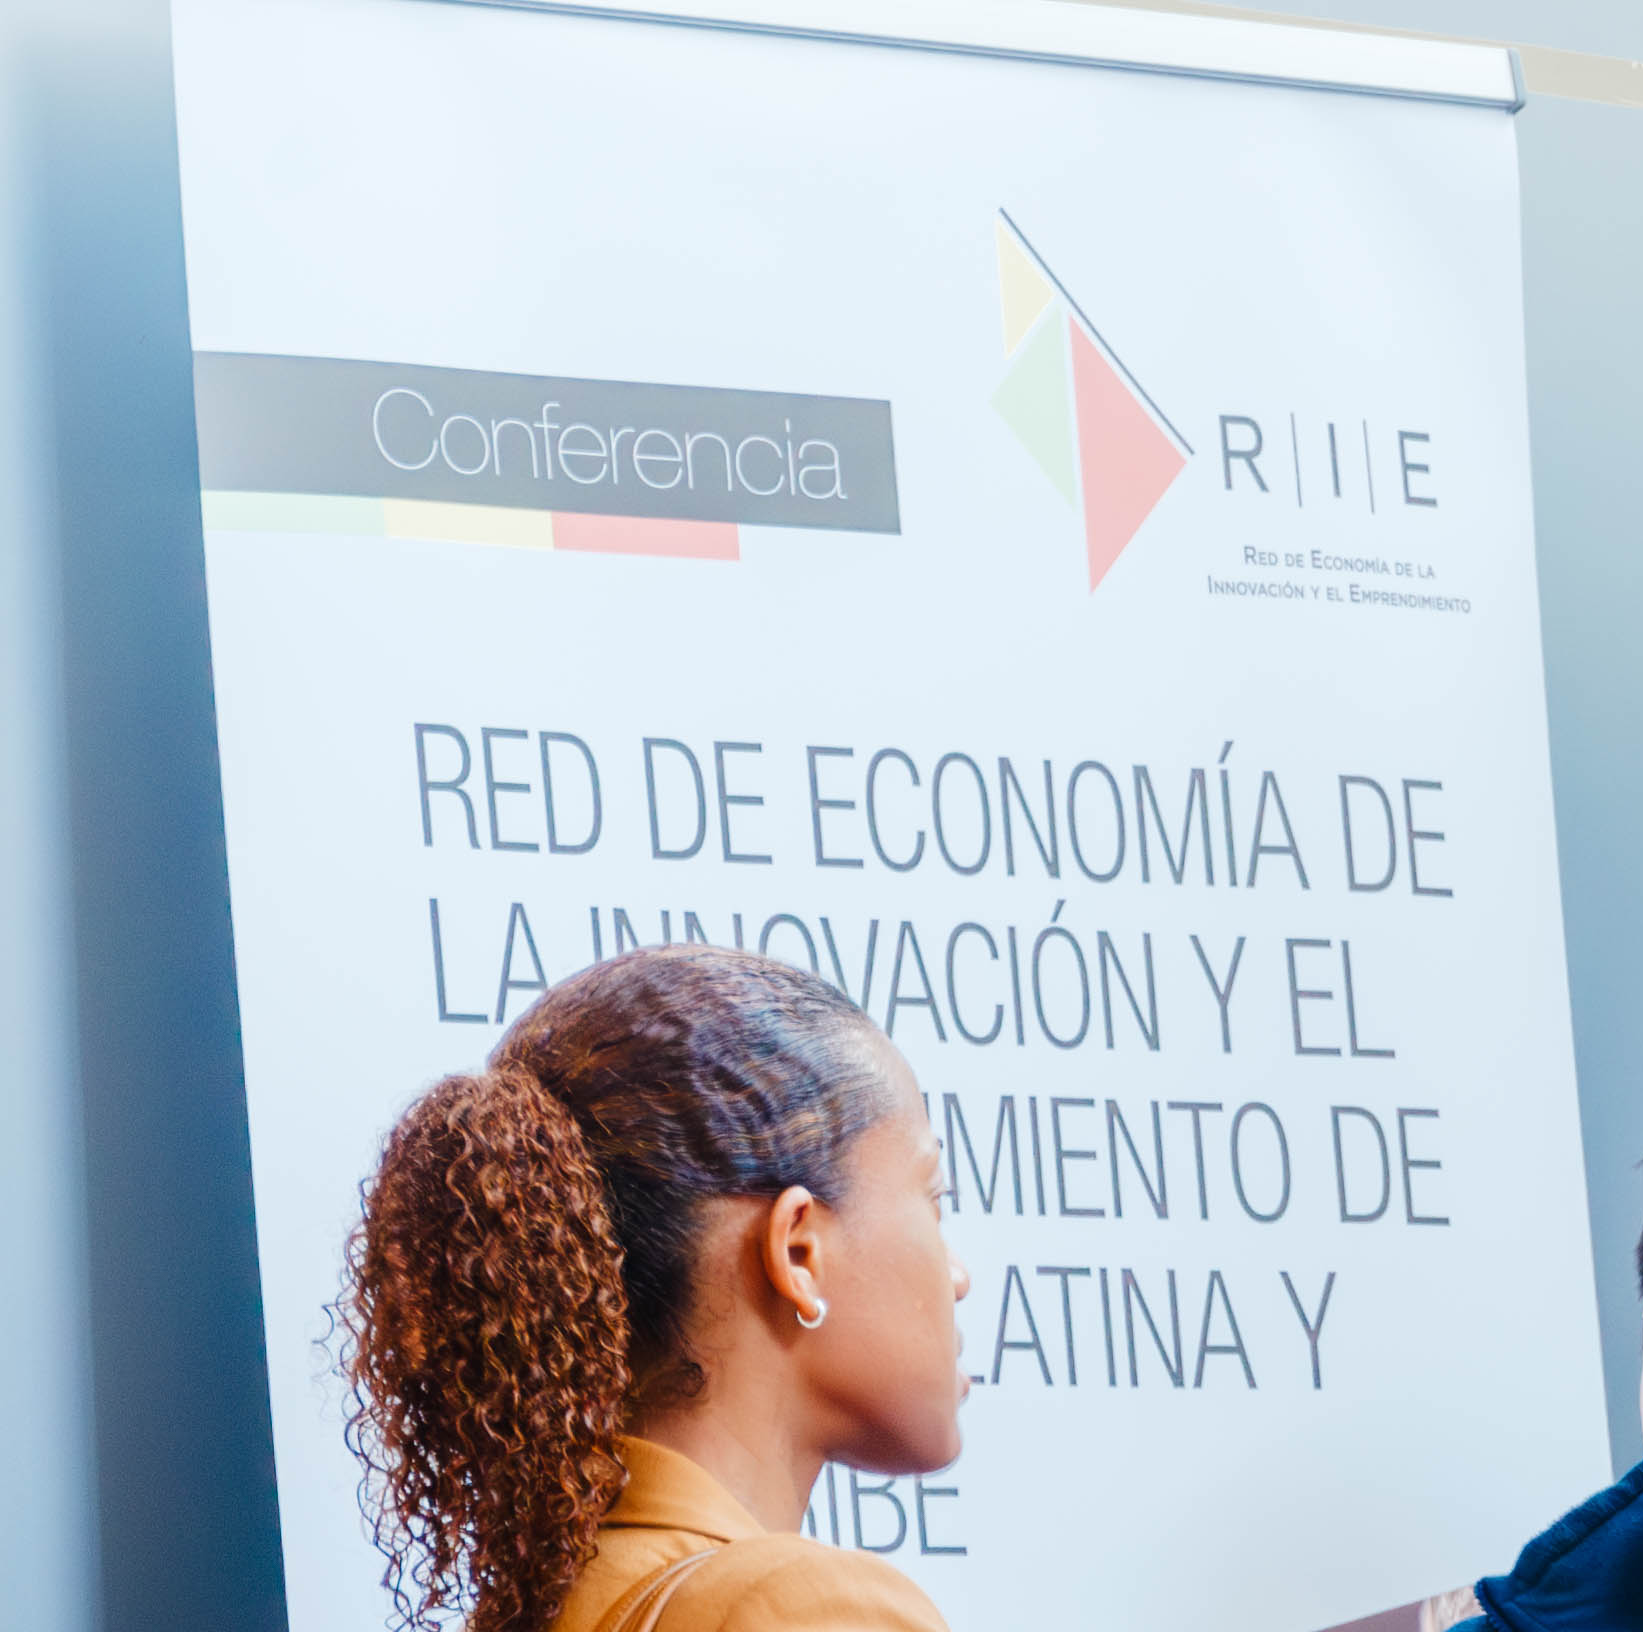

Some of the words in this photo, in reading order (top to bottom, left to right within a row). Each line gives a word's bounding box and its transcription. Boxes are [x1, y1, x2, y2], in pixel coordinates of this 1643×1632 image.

[372, 387, 848, 502] Conferencia
[413, 722, 605, 856] RED
[642, 736, 773, 866] DE
[806, 740, 1311, 891] ECONOMÍA
[1339, 773, 1455, 900] DE
[429, 897, 548, 1026] LA
[589, 897, 1162, 1054] VACIÓN
[1191, 935, 1247, 1056] Y
[1285, 936, 1397, 1060] EL
[921, 1092, 1292, 1224] MIENTO
[1333, 1105, 1451, 1228] DE
[969, 1264, 1258, 1391] ATINA
[1280, 1270, 1338, 1392] Y
[803, 1462, 968, 1556] IBE
